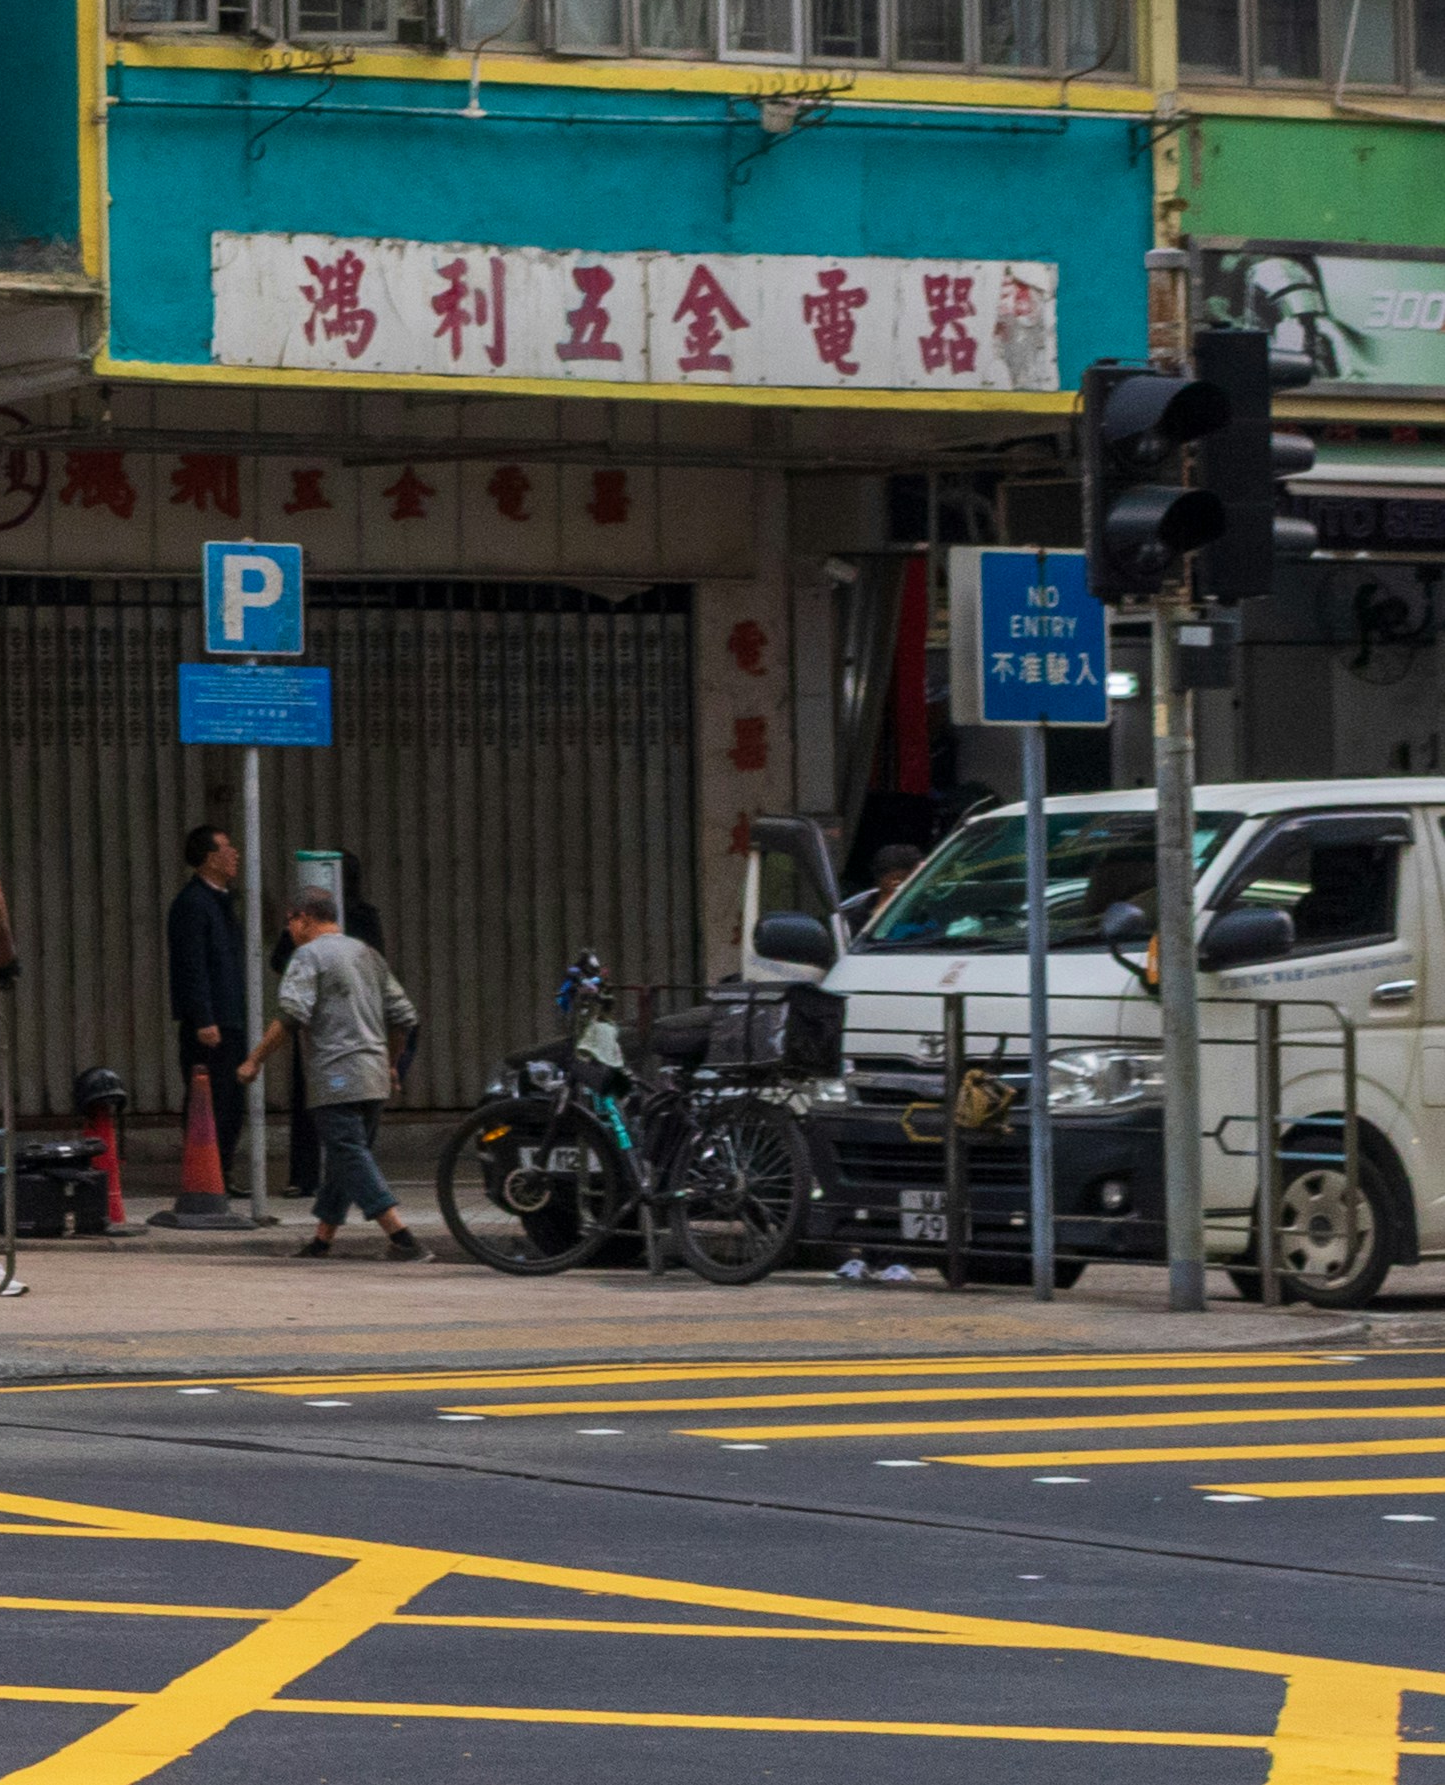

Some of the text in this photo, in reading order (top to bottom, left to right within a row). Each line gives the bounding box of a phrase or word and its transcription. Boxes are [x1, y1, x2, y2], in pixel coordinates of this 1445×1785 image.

[300, 249, 978, 375] 鴻利五金電器
[223, 554, 285, 642] P
[1009, 585, 1079, 639] NO ENTRY
[990, 650, 1100, 686] 不准駛入
